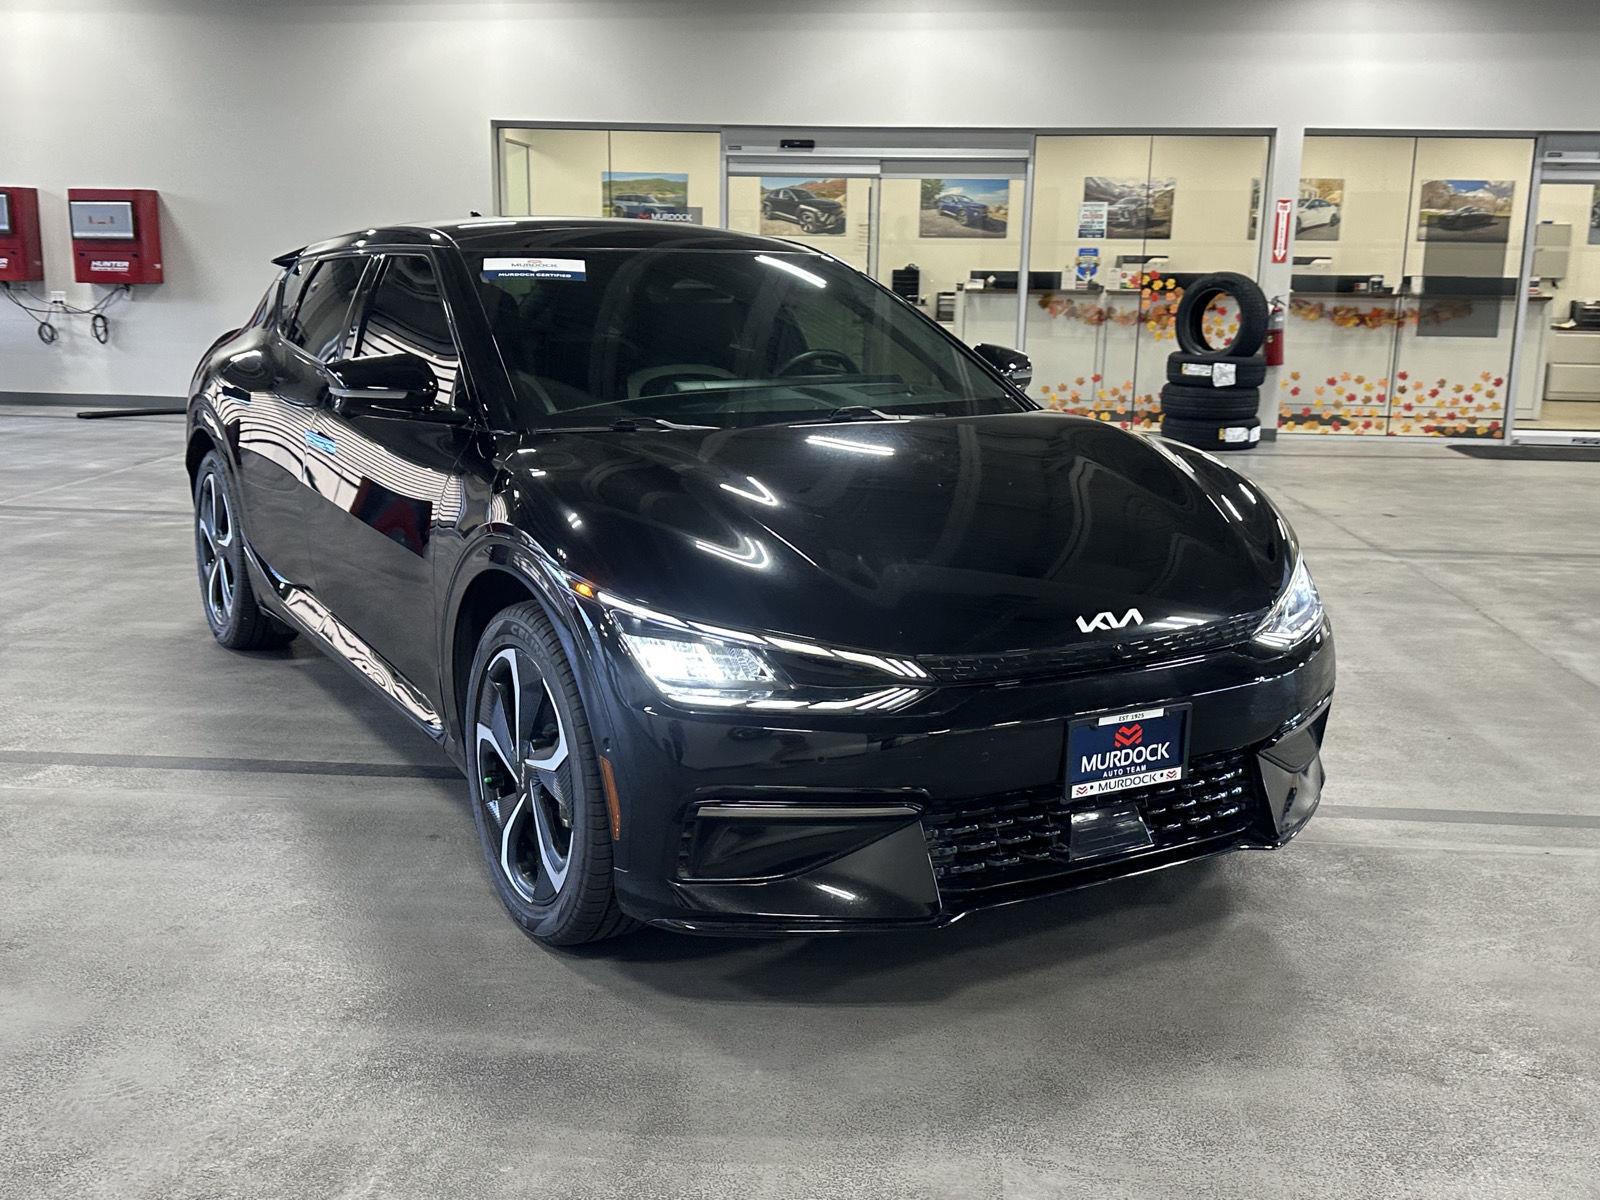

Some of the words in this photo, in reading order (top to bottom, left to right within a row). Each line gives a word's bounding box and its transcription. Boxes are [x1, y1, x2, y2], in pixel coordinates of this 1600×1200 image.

[1076, 608, 1144, 633] KIA
[1081, 741, 1170, 773] MURDOCK
[1103, 769, 1124, 778] AUTO
[1126, 764, 1147, 774] TEAM
[1098, 773, 1158, 792] MURDOCK
